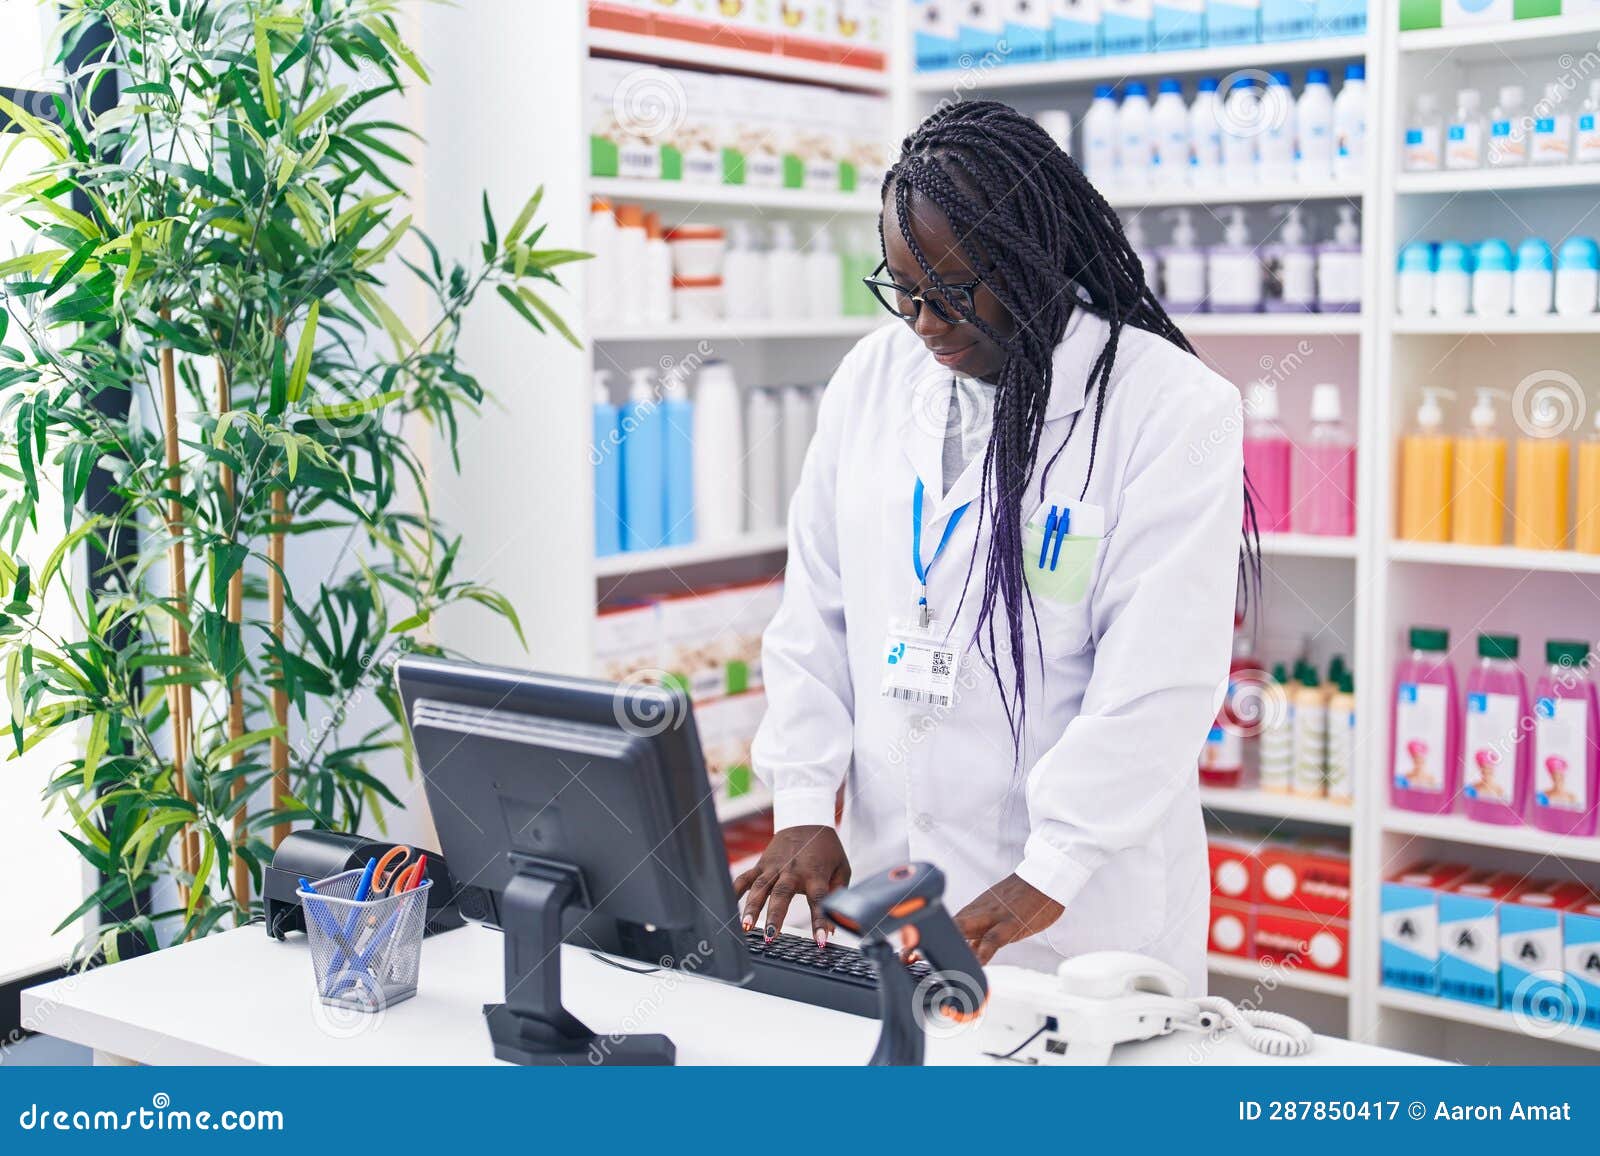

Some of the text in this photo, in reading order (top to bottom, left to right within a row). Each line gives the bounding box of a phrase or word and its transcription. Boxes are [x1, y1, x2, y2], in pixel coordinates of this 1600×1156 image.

[1399, 919, 1416, 937] A
[1457, 930, 1475, 948] A
[1520, 941, 1538, 960] A
